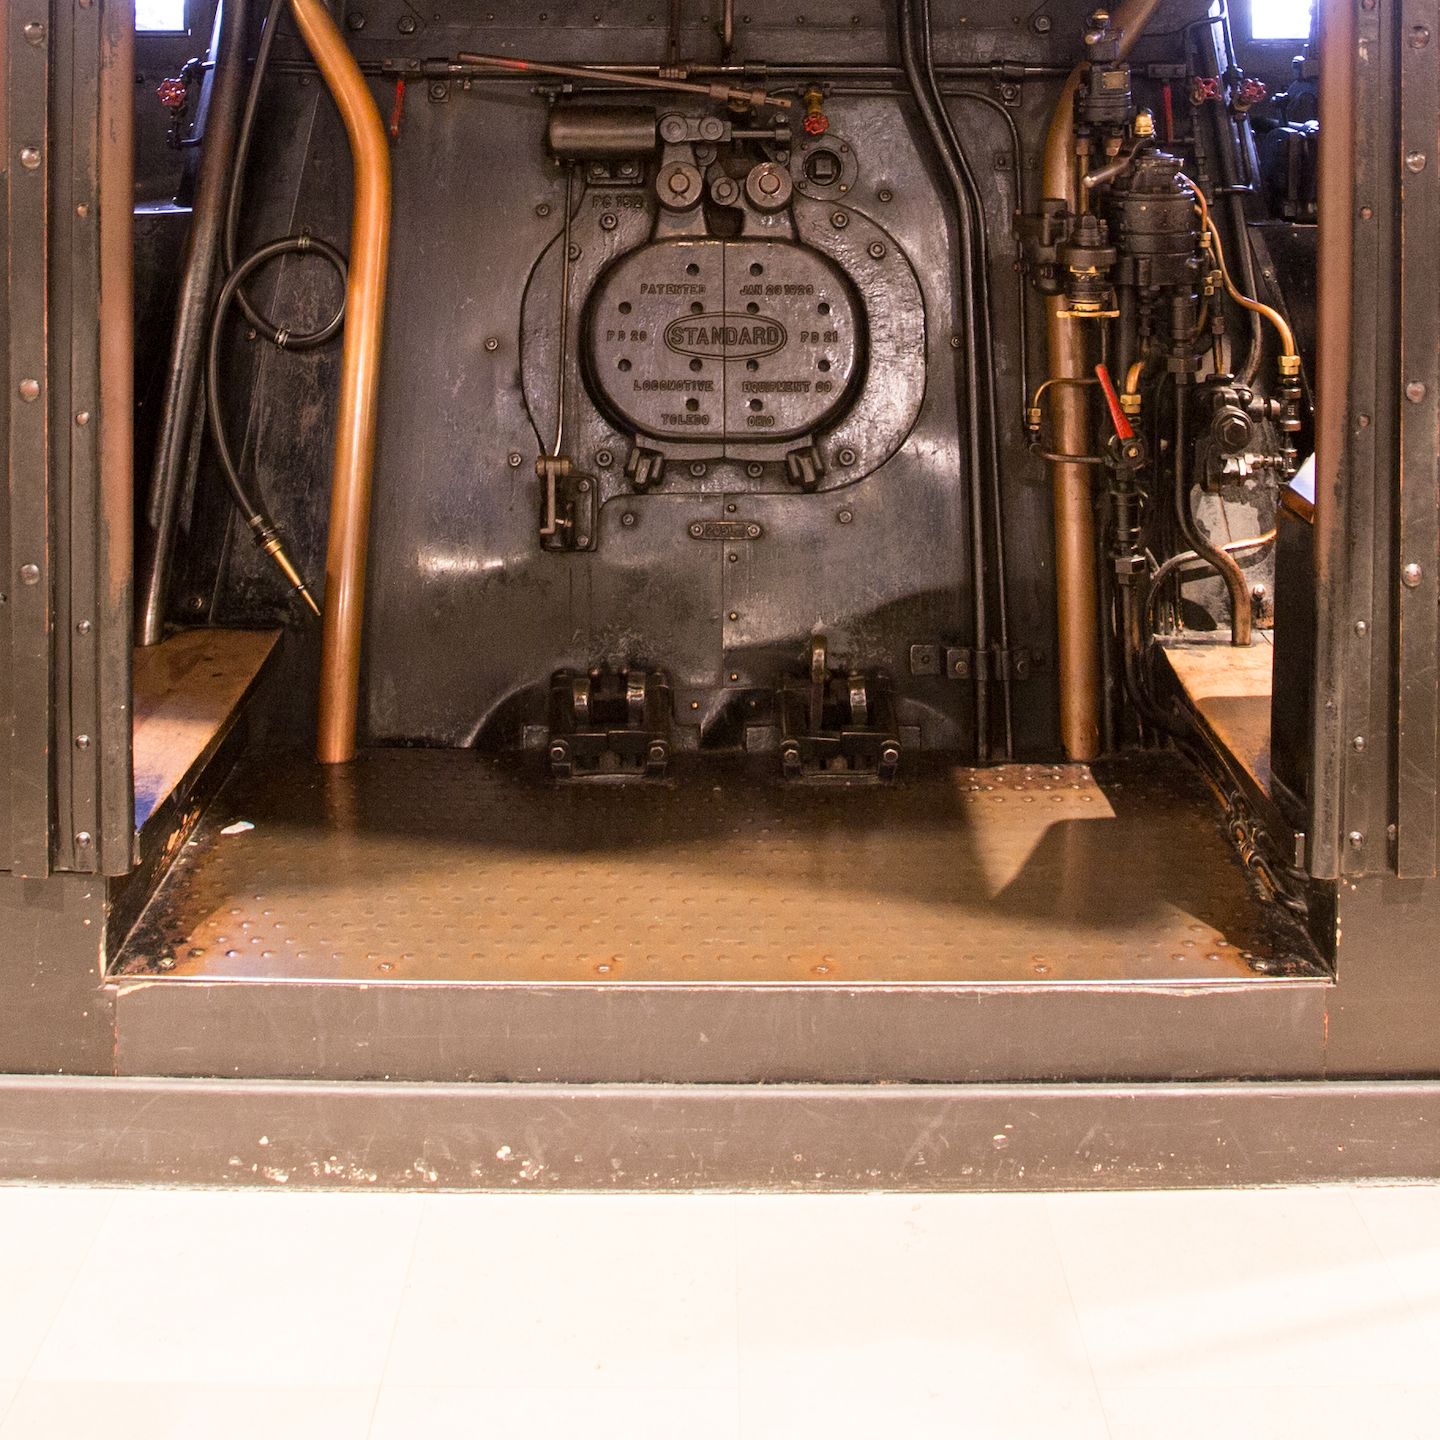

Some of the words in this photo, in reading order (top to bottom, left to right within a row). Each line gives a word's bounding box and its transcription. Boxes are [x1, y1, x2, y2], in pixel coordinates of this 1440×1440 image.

[739, 284, 763, 296] JAN
[670, 325, 779, 346] STANDARD
[823, 330, 839, 343] 21
[633, 379, 714, 392] LOCOMOTIVE
[741, 380, 812, 393] EQUIPMENT
[661, 413, 710, 426] TOLEDO
[746, 415, 775, 427] OHIO
